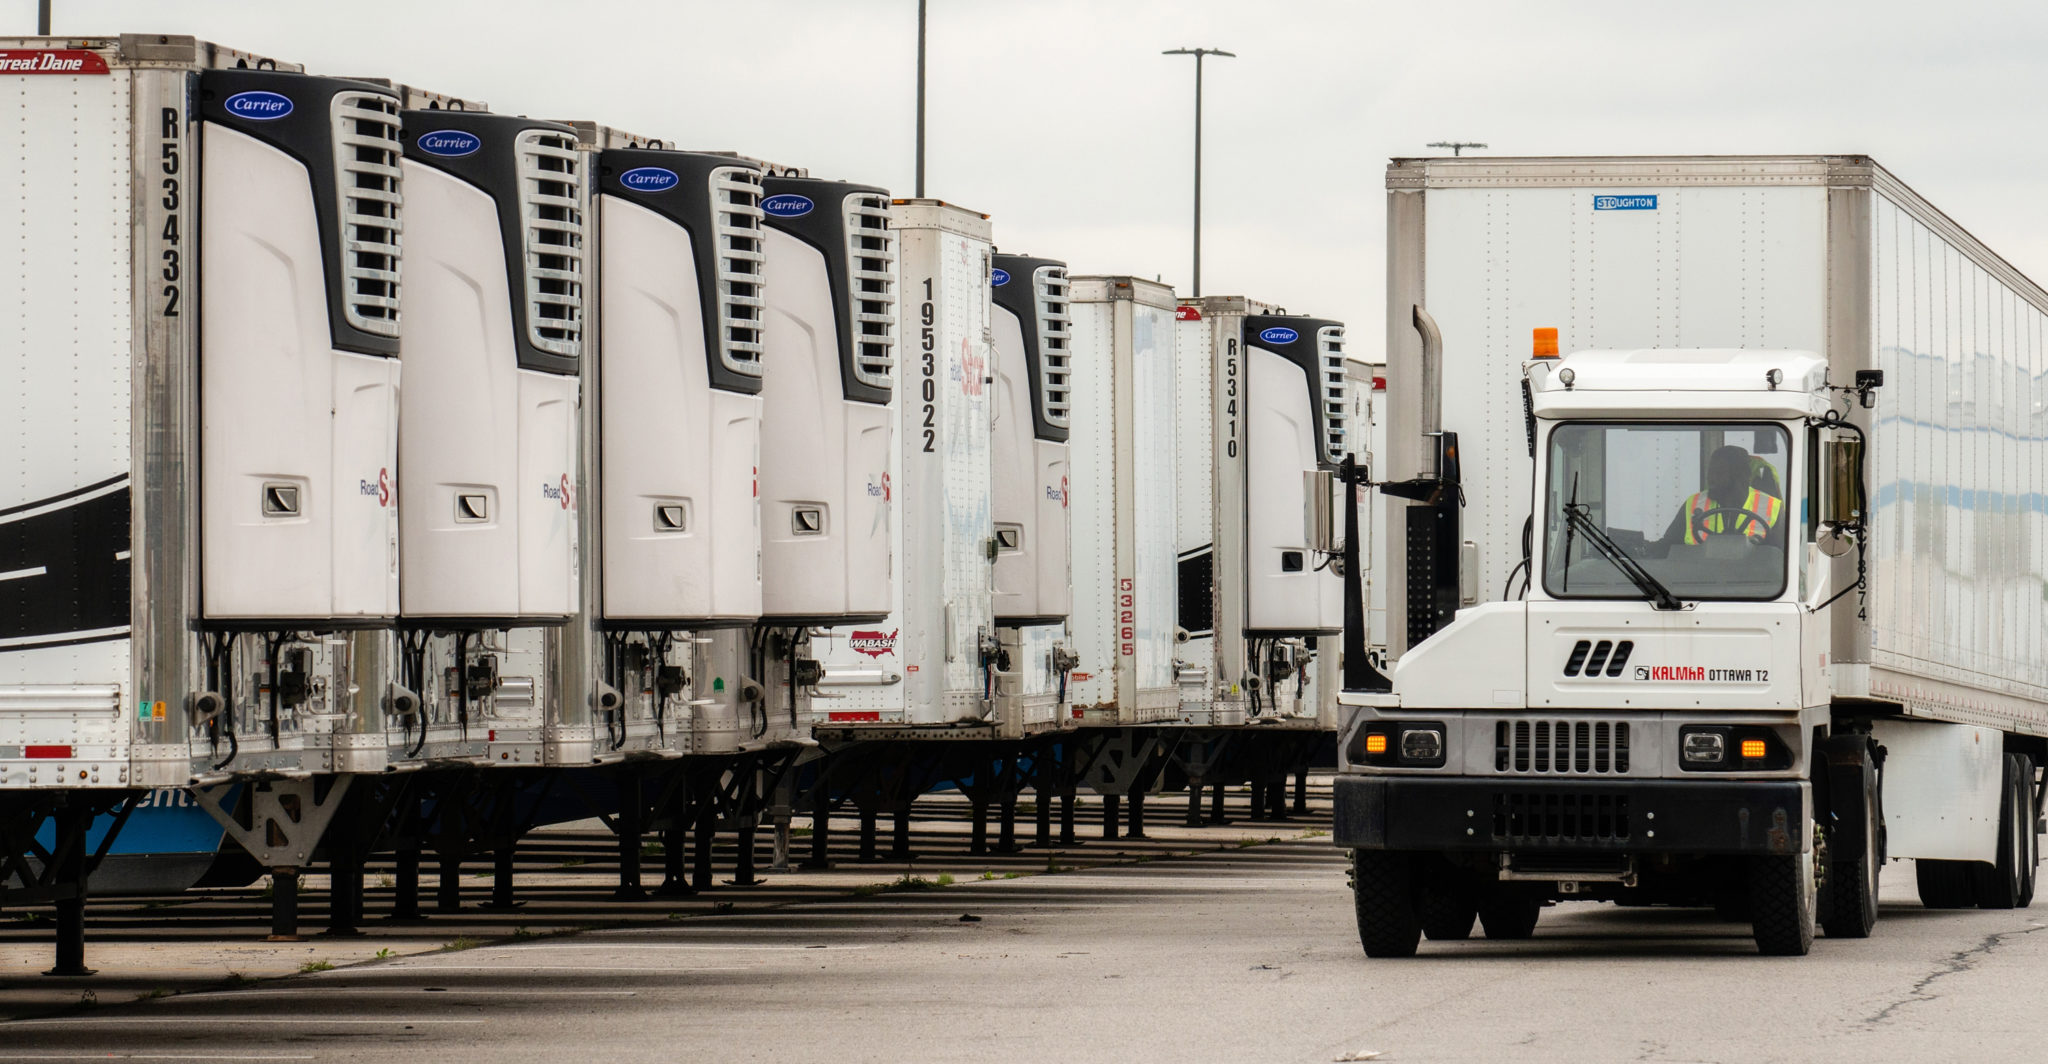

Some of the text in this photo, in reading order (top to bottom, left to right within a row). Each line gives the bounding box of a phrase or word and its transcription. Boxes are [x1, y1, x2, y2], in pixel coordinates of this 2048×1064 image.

[39, 53, 83, 71] Dane
[234, 98, 285, 111] Carrier
[426, 136, 473, 149] Carrier
[628, 173, 672, 184] Carrier
[767, 200, 808, 210] Carrier
[1597, 197, 1654, 208] STOUGHTON
[162, 107, 179, 317] R53432
[1265, 331, 1294, 339] Carrier
[922, 278, 936, 453] 1953022
[1227, 338, 1237, 458] R53410
[1120, 578, 1134, 656] 53265
[850, 639, 897, 648] WABASH
[1652, 666, 1769, 682] KALMAR OTTAWA T2
